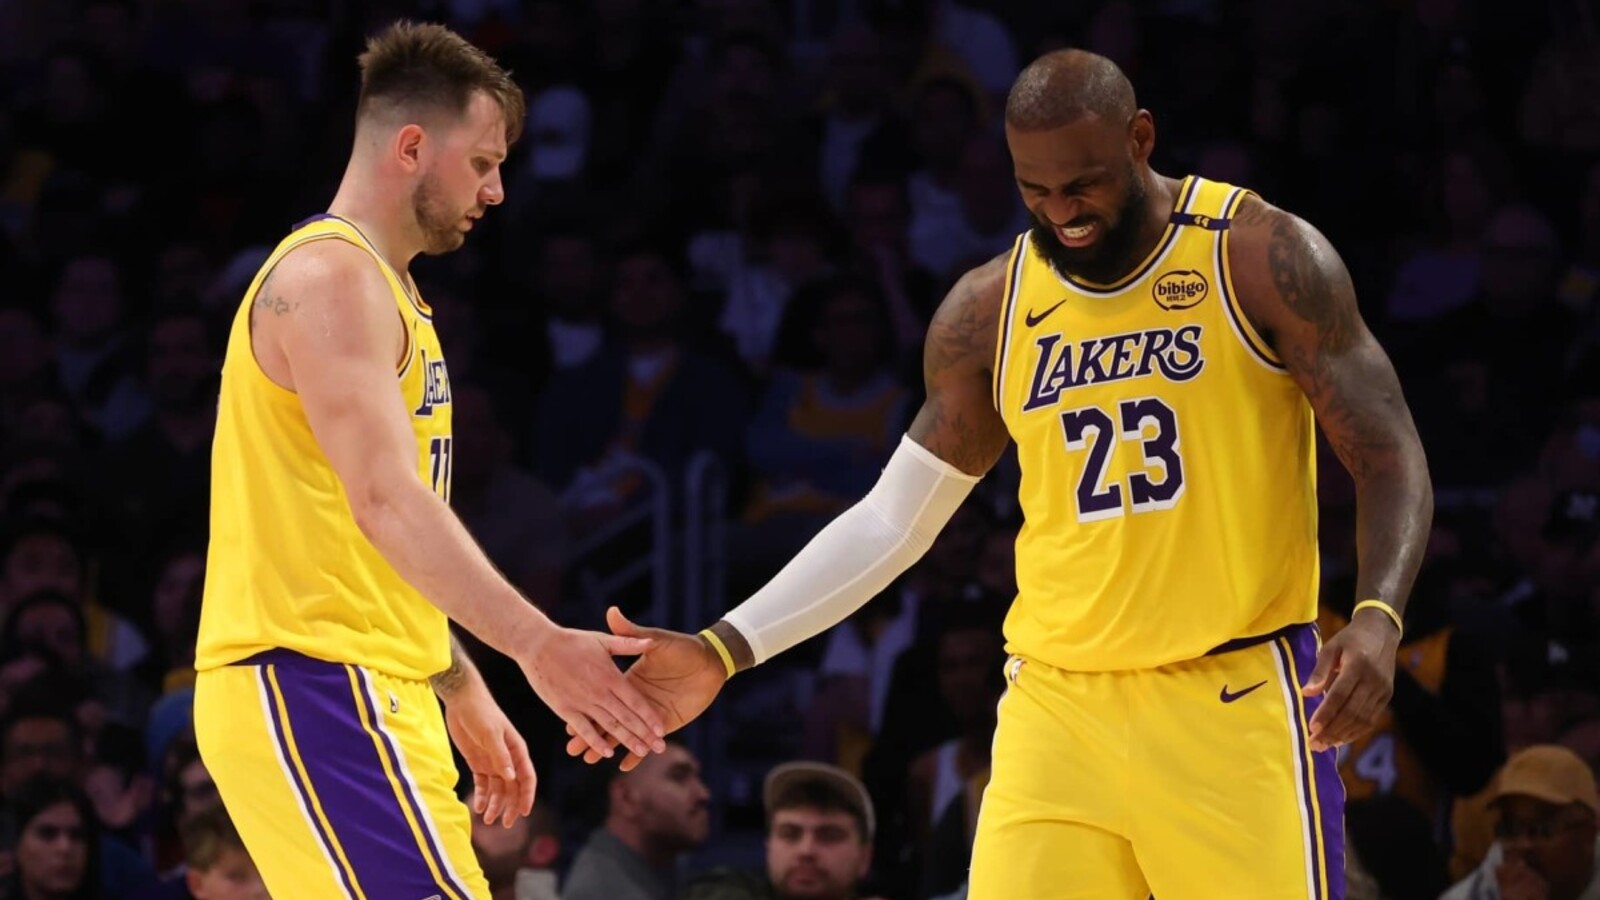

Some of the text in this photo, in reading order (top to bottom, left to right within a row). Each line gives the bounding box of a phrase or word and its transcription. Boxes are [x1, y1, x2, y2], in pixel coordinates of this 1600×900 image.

[1158, 280, 1205, 297] bibigo
[1022, 325, 1205, 414] LAKERS
[1060, 396, 1186, 523] 23
